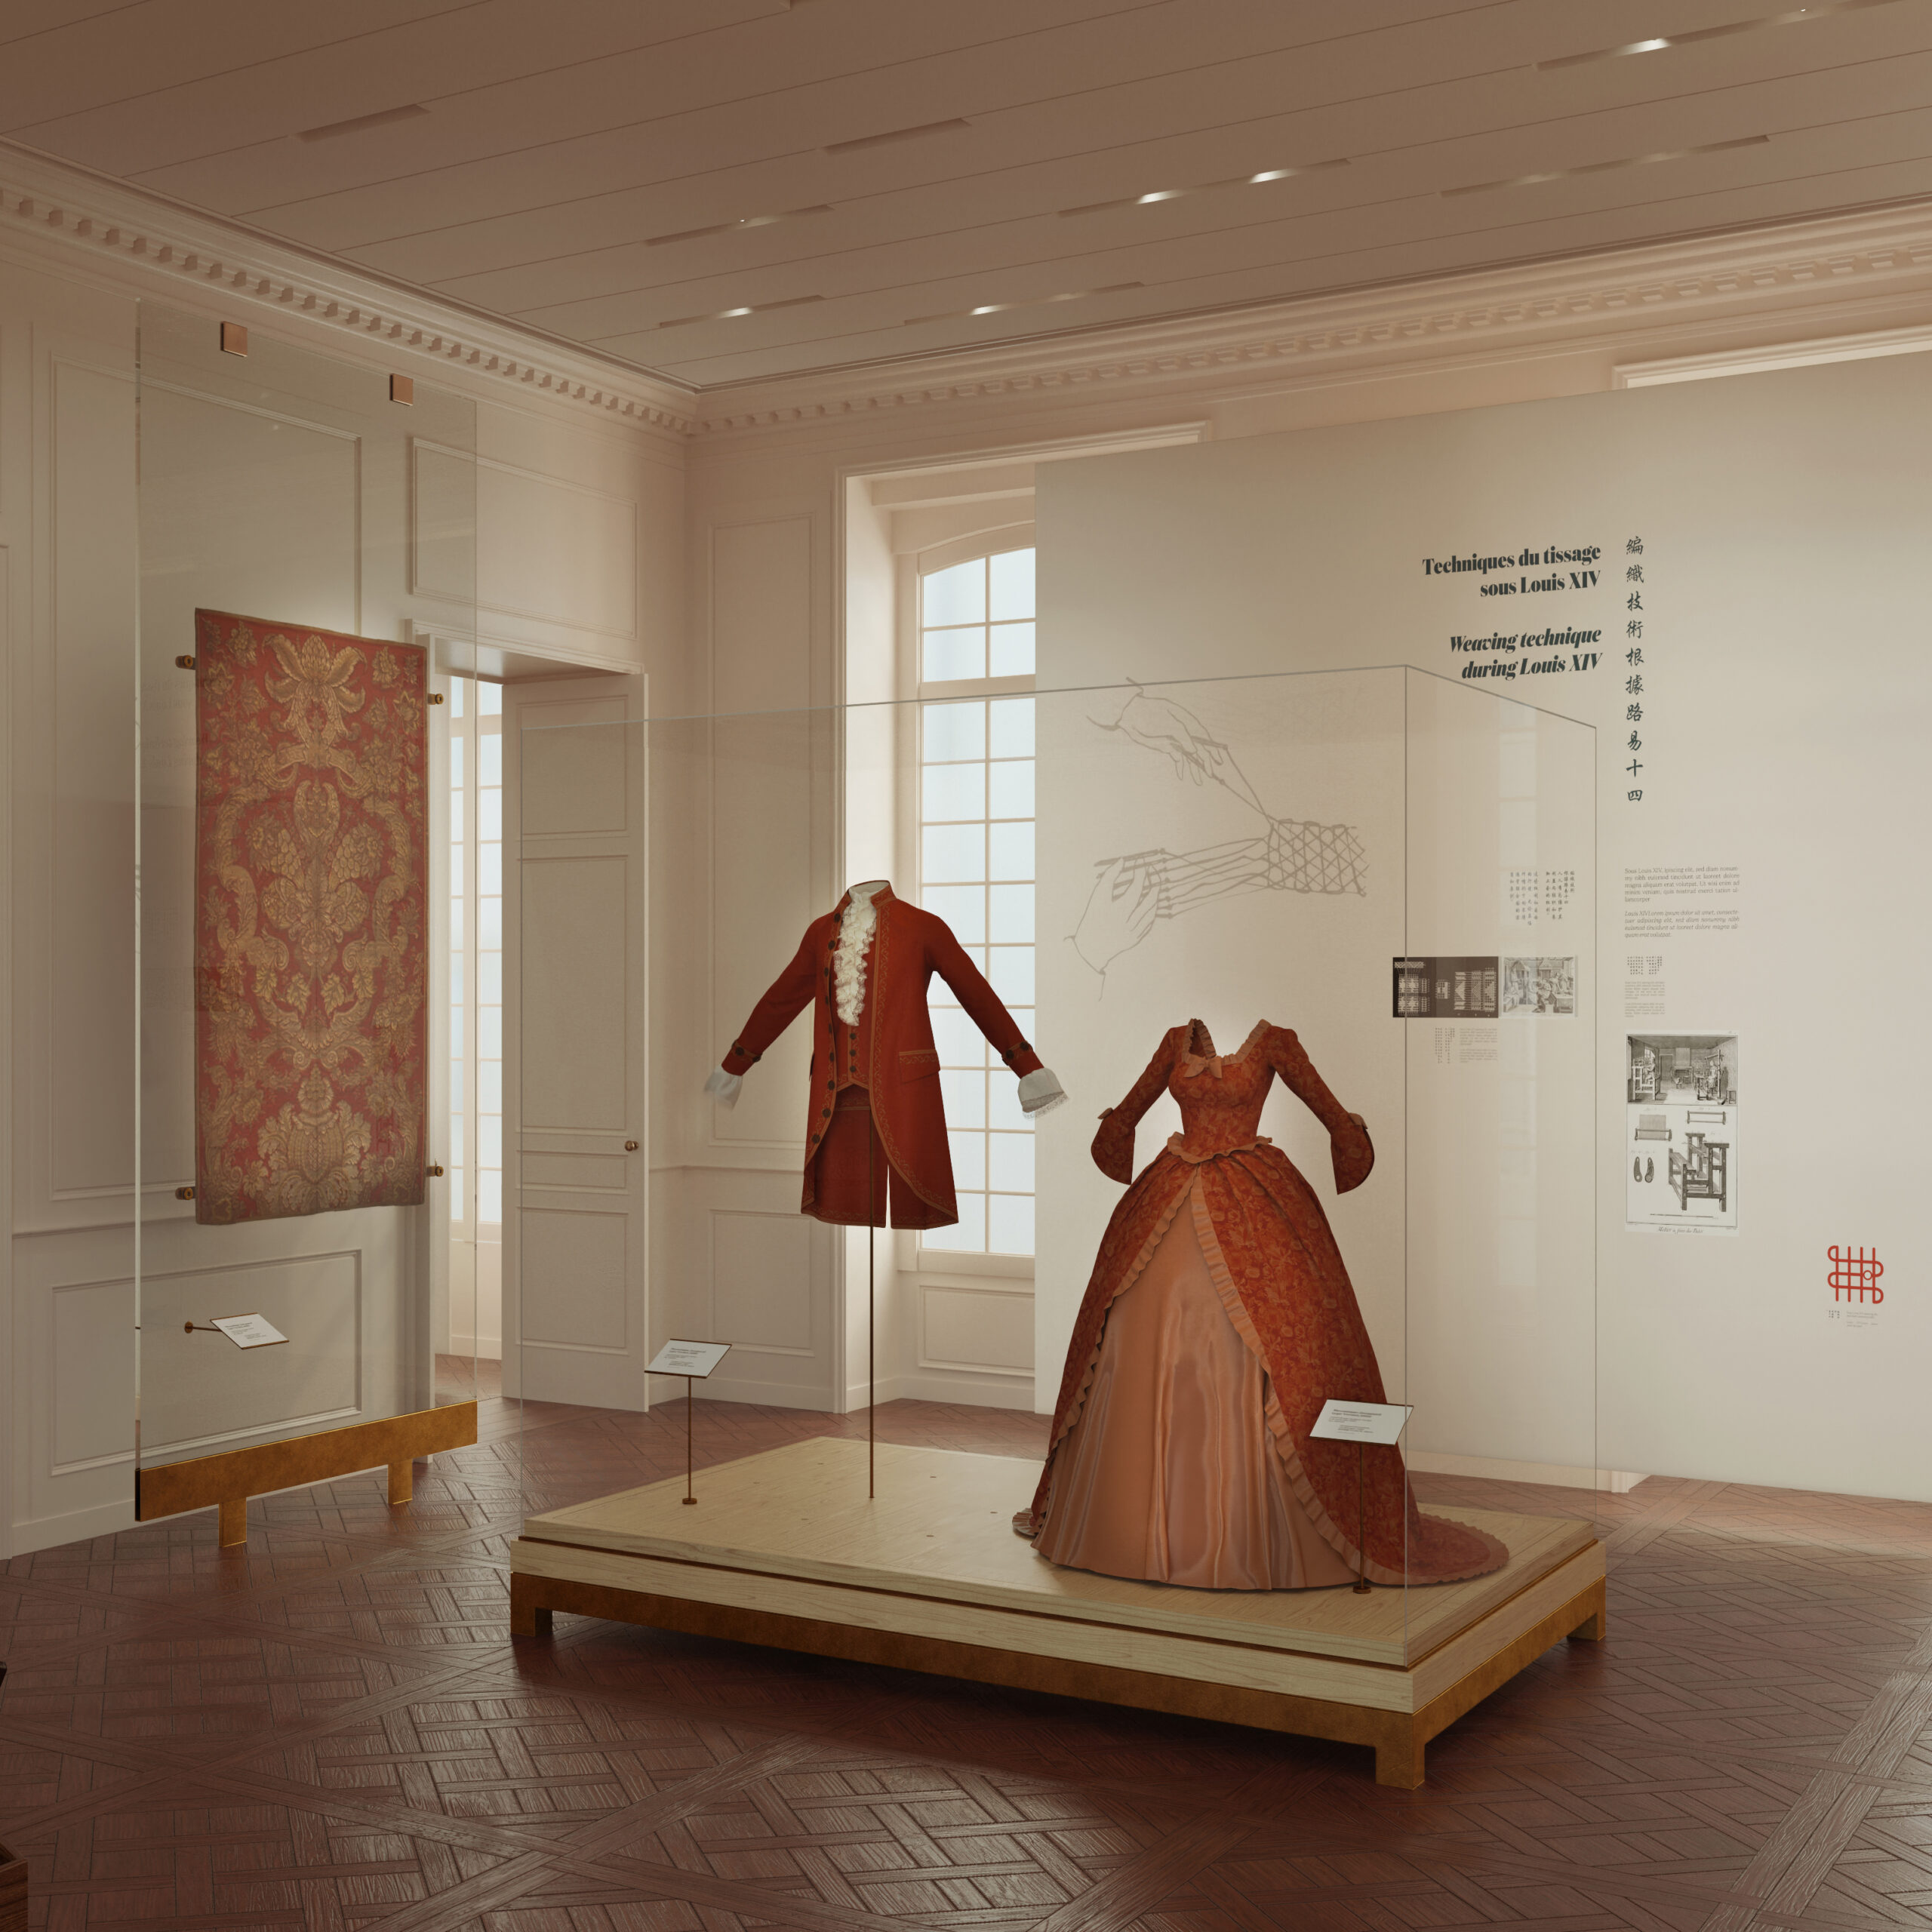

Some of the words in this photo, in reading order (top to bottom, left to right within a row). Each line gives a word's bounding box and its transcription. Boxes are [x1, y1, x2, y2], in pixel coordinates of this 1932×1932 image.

[1422, 553, 1515, 575] Techniques
[1518, 548, 1540, 566] du
[1543, 545, 1601, 565] tissage
[1481, 583, 1517, 597] sous
[1521, 573, 1565, 594] Louis
[1569, 571, 1601, 589] XIV
[1450, 632, 1518, 654] Weaving
[1520, 626, 1601, 648] technique
[1462, 660, 1518, 681] during
[1519, 655, 1566, 675] Louis
[1569, 653, 1603, 672] XIV
[1626, 535, 1644, 802] 編織技術根據路易十四
